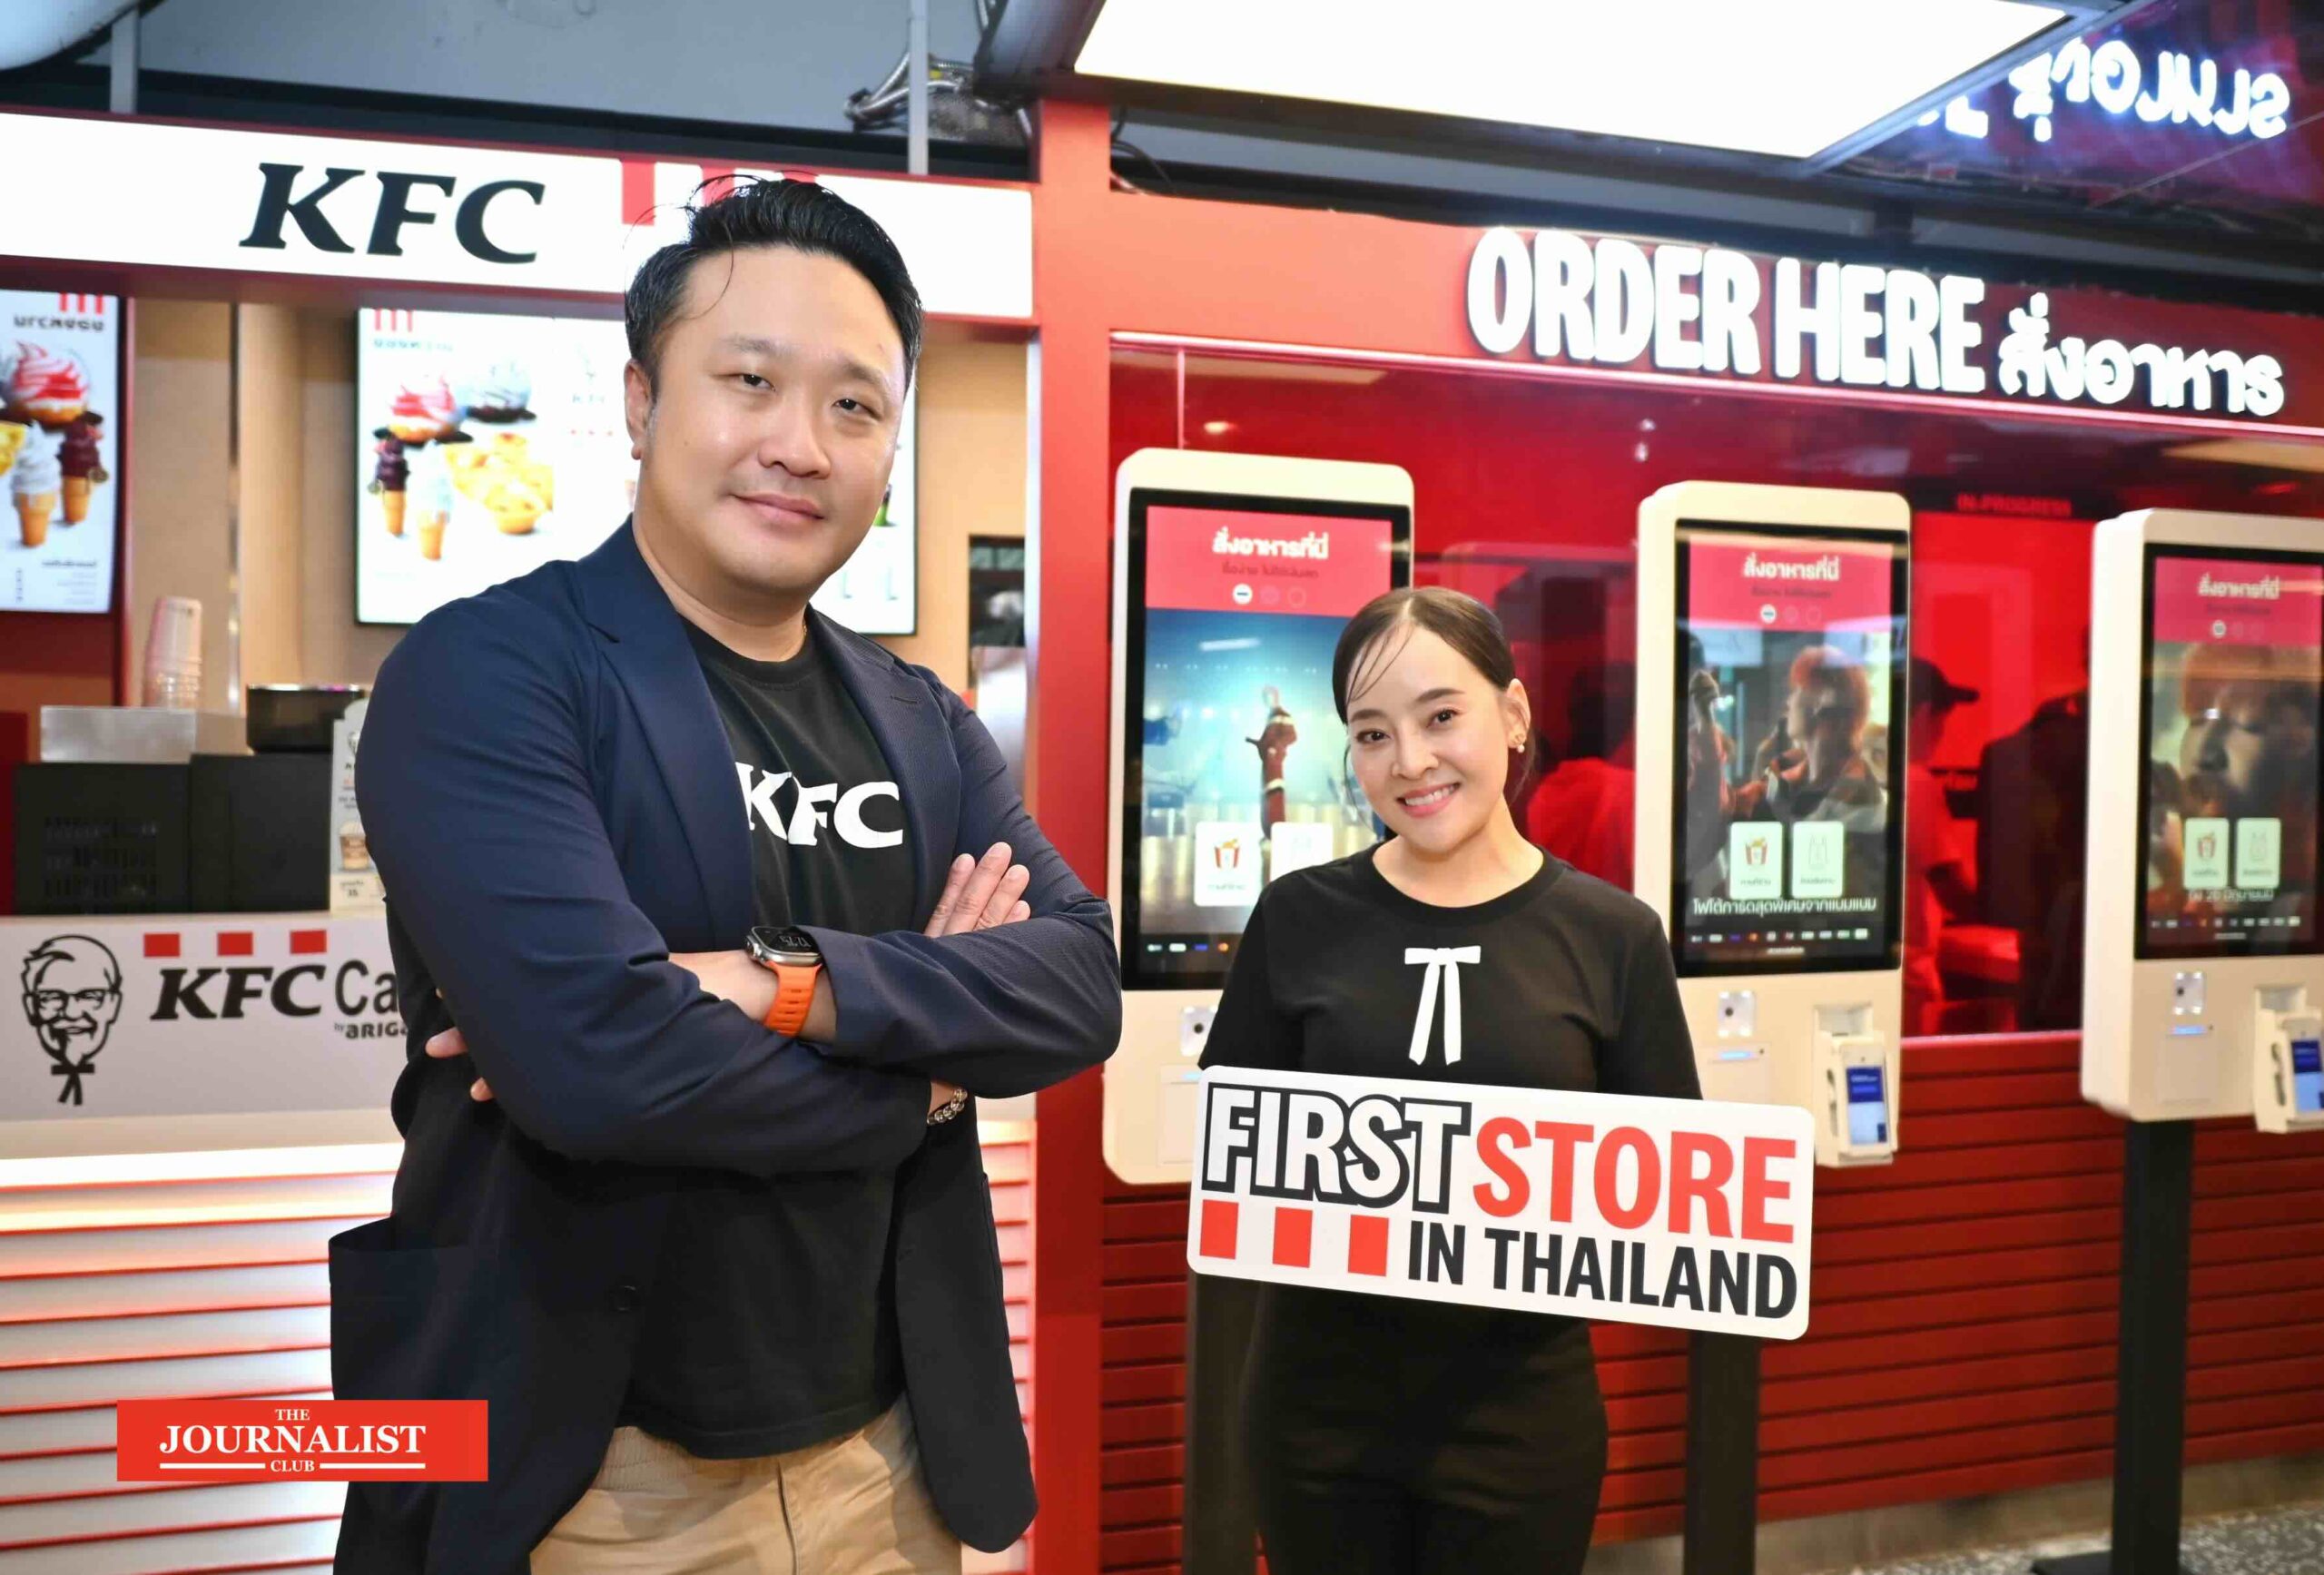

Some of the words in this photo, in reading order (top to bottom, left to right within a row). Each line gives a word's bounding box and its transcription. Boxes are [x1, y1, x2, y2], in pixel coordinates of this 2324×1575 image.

[239, 162, 546, 264] KFC
[1467, 227, 1763, 376] ORDER
[1774, 258, 1986, 395] HERE
[1998, 292, 2285, 418] สั่งอาหาร
[1212, 526, 1329, 560] สั่งอาหารที่นี่
[1742, 550, 1840, 583] สั่งอาหารที่นี่
[734, 762, 903, 849] KFC
[150, 964, 326, 1020] KFC
[1202, 1082, 1472, 1215] FIRST
[1472, 1117, 1797, 1244] STORE
[1408, 1220, 1467, 1285] IN
[1484, 1227, 1797, 1319] THAILAND
